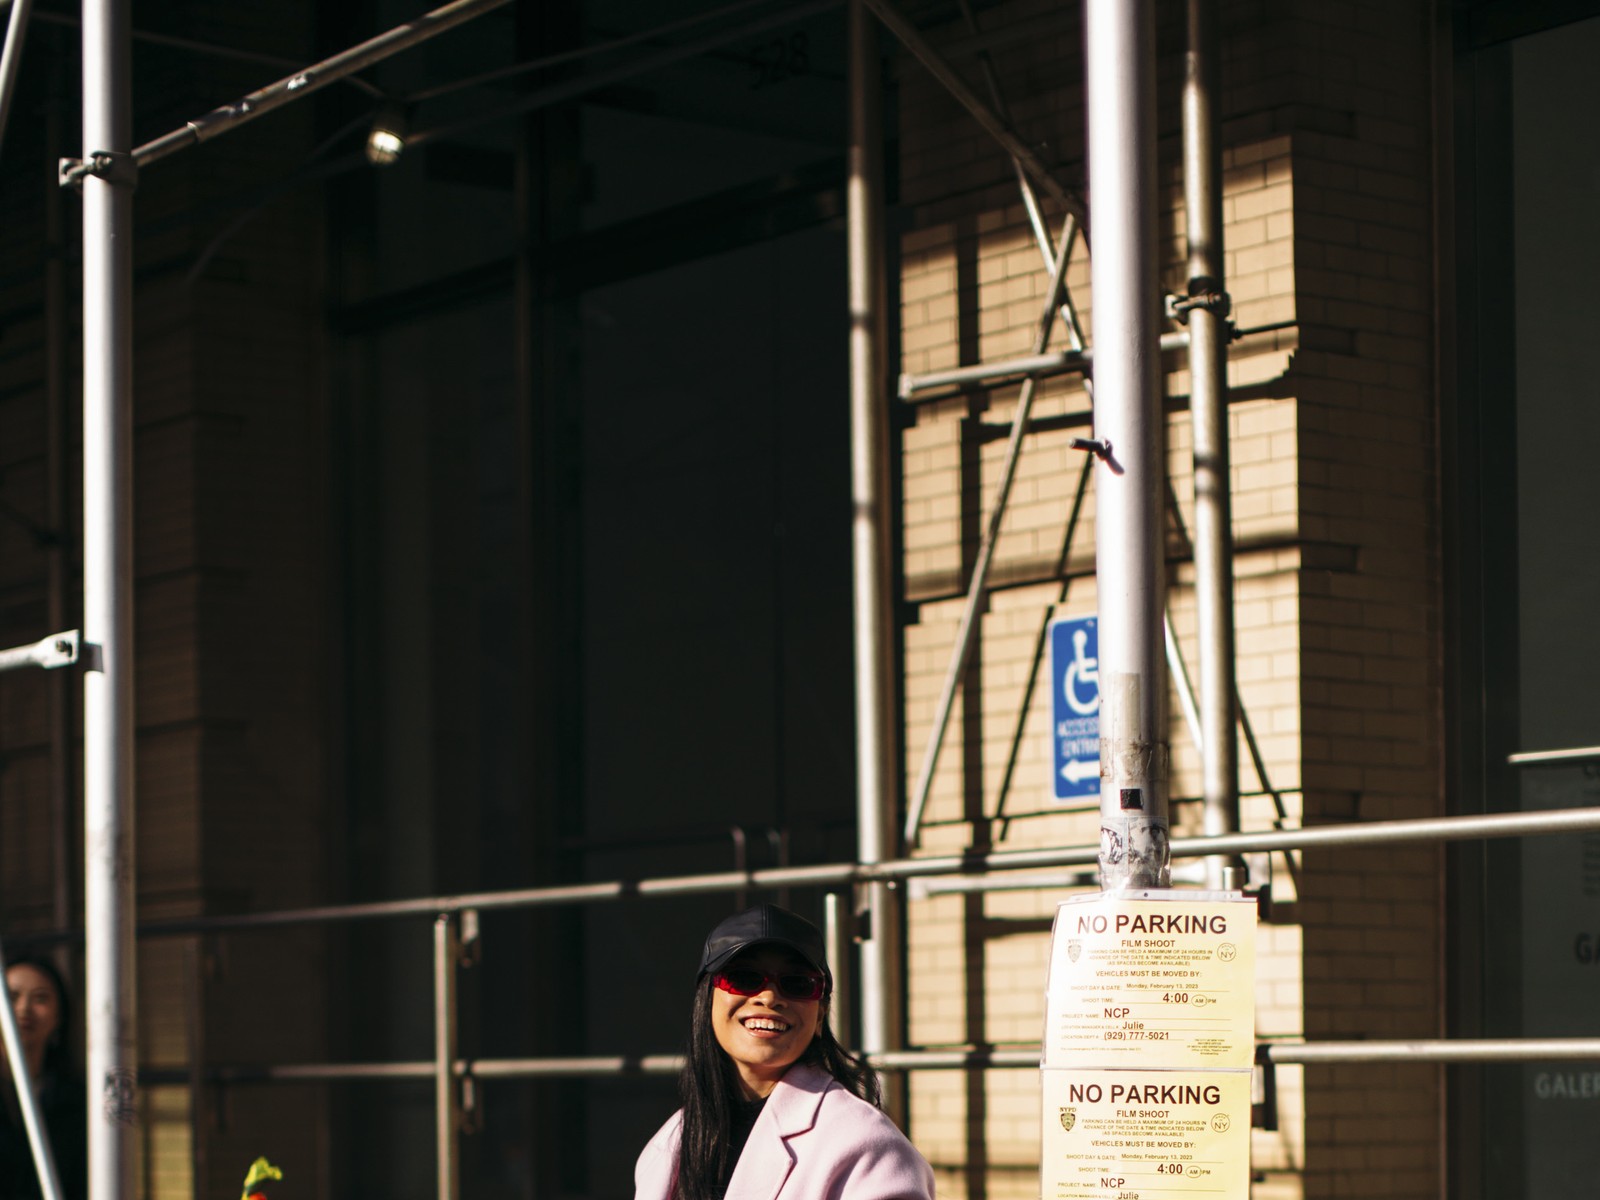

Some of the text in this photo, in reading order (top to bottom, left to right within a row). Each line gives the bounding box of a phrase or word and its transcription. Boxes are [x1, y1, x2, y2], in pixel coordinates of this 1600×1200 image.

[749, 31, 810, 90] 528
[1078, 915, 1226, 934] NO PARKING
[1121, 939, 1175, 947] FILM SHOOT
[1163, 993, 1189, 1004] 4:00
[1104, 1008, 1130, 1018] NCP
[1122, 1021, 1144, 1030] Julie
[1104, 1032, 1169, 1040] (929) 777-5021
[1070, 1084, 1220, 1105] NO PARKING
[1117, 1110, 1170, 1118] FILM SHOOT
[1157, 1164, 1183, 1174] 4:00
[1101, 1177, 1125, 1188] NCP
[1118, 1192, 1139, 1200] Julie
